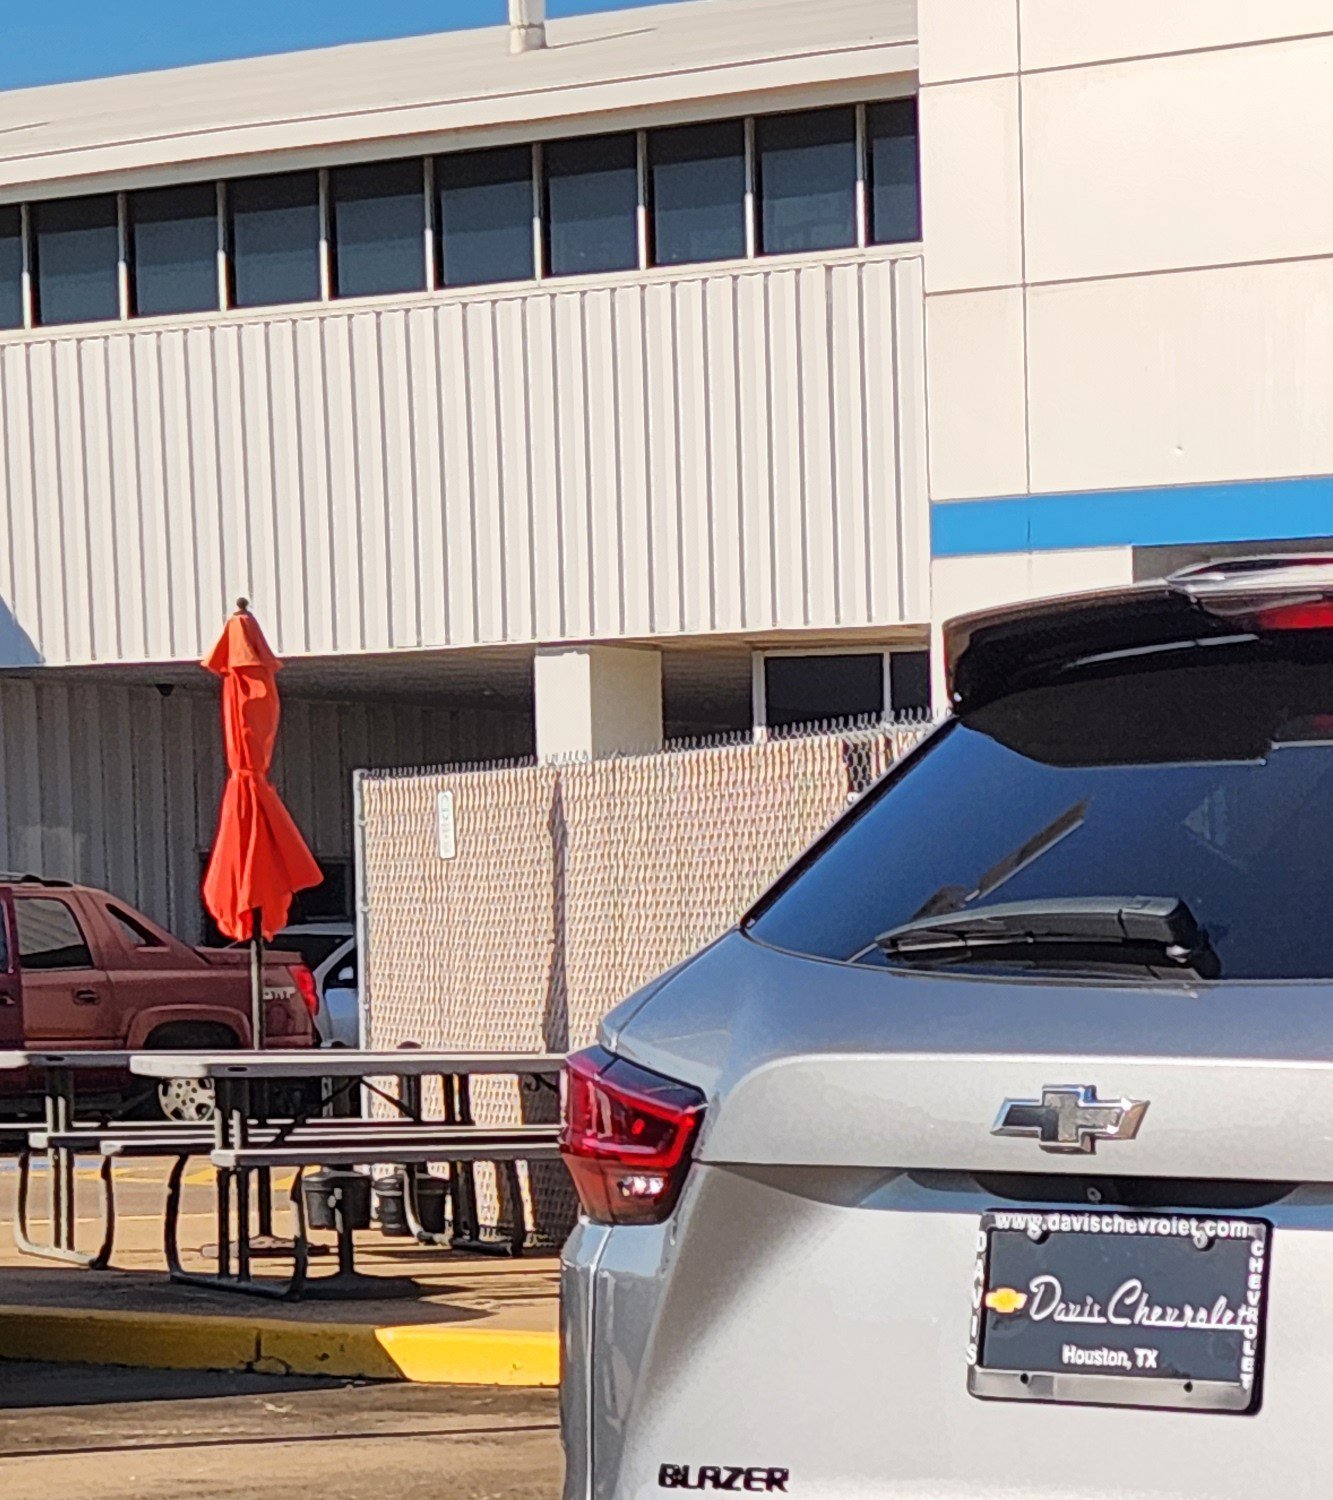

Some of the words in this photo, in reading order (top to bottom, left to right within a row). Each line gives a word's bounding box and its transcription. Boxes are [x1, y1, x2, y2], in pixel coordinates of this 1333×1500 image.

[966, 1230, 987, 1366] DAVIS
[1029, 1274, 1107, 1323] Davis
[1107, 1278, 1251, 1330] Chevrolet
[1239, 1239, 1264, 1390] CHEVROLET
[1062, 1344, 1132, 1371] Houston,
[1133, 1347, 1159, 1369] TX
[658, 1463, 789, 1493] BLAZER
